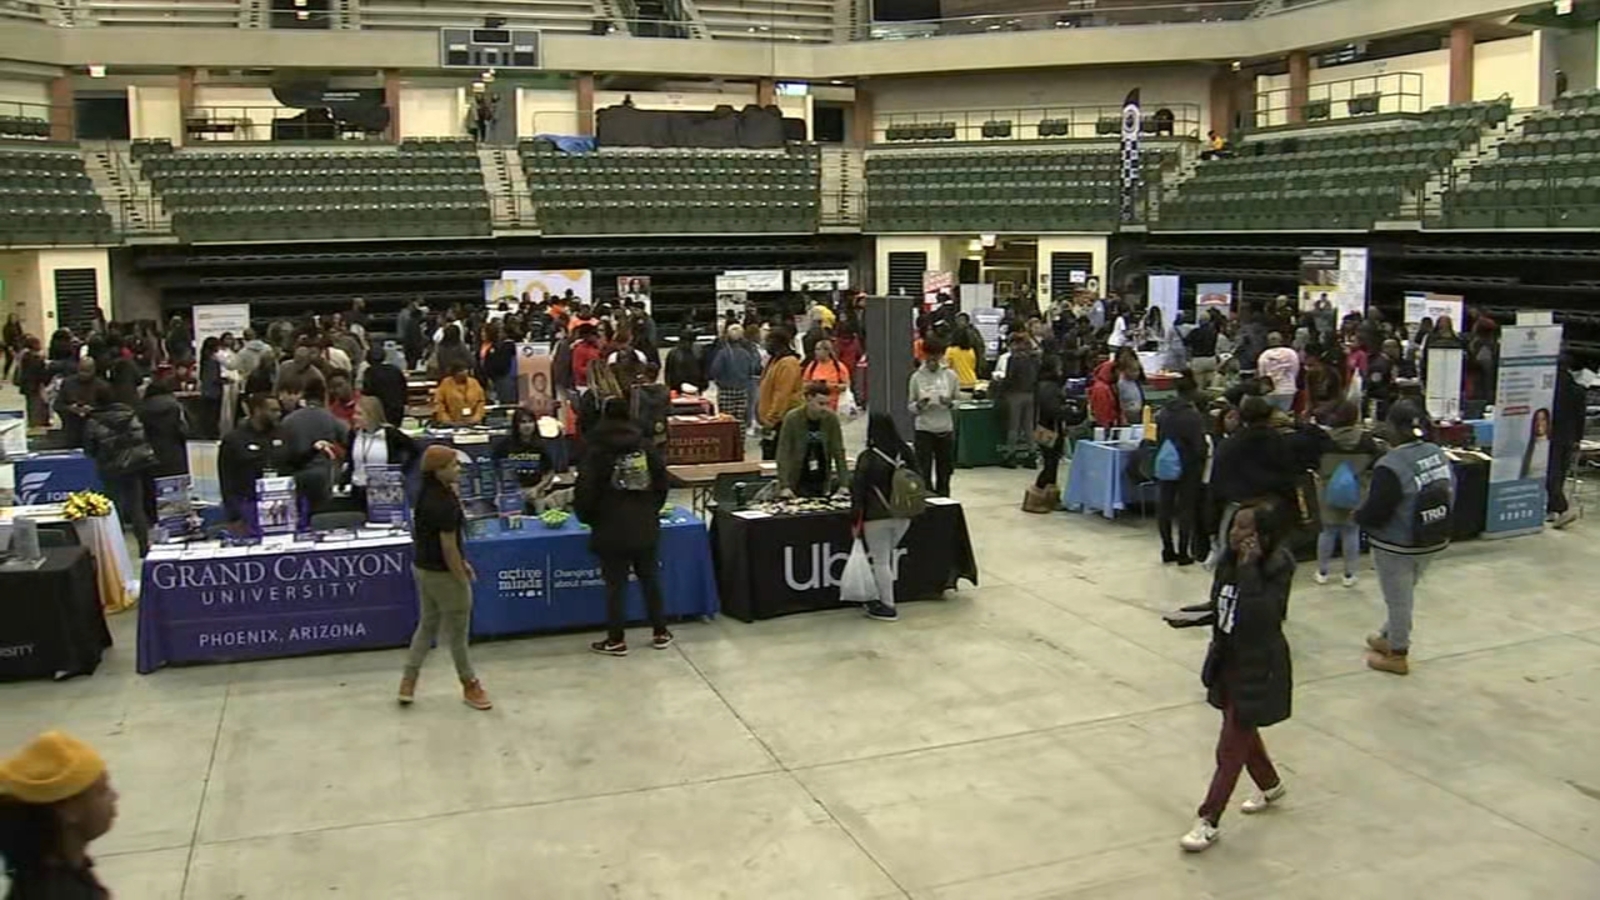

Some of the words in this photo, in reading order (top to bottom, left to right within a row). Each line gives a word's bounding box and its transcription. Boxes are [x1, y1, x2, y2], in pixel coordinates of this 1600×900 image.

[152, 561, 266, 589] GRAND
[273, 551, 405, 582] CANYON
[498, 568, 543, 580] active
[784, 541, 908, 591] Ubr
[201, 581, 358, 606] UNIVERSITY
[498, 579, 543, 591] minds
[199, 629, 285, 648] PHOENIX,
[288, 622, 367, 642] ARIZONA
